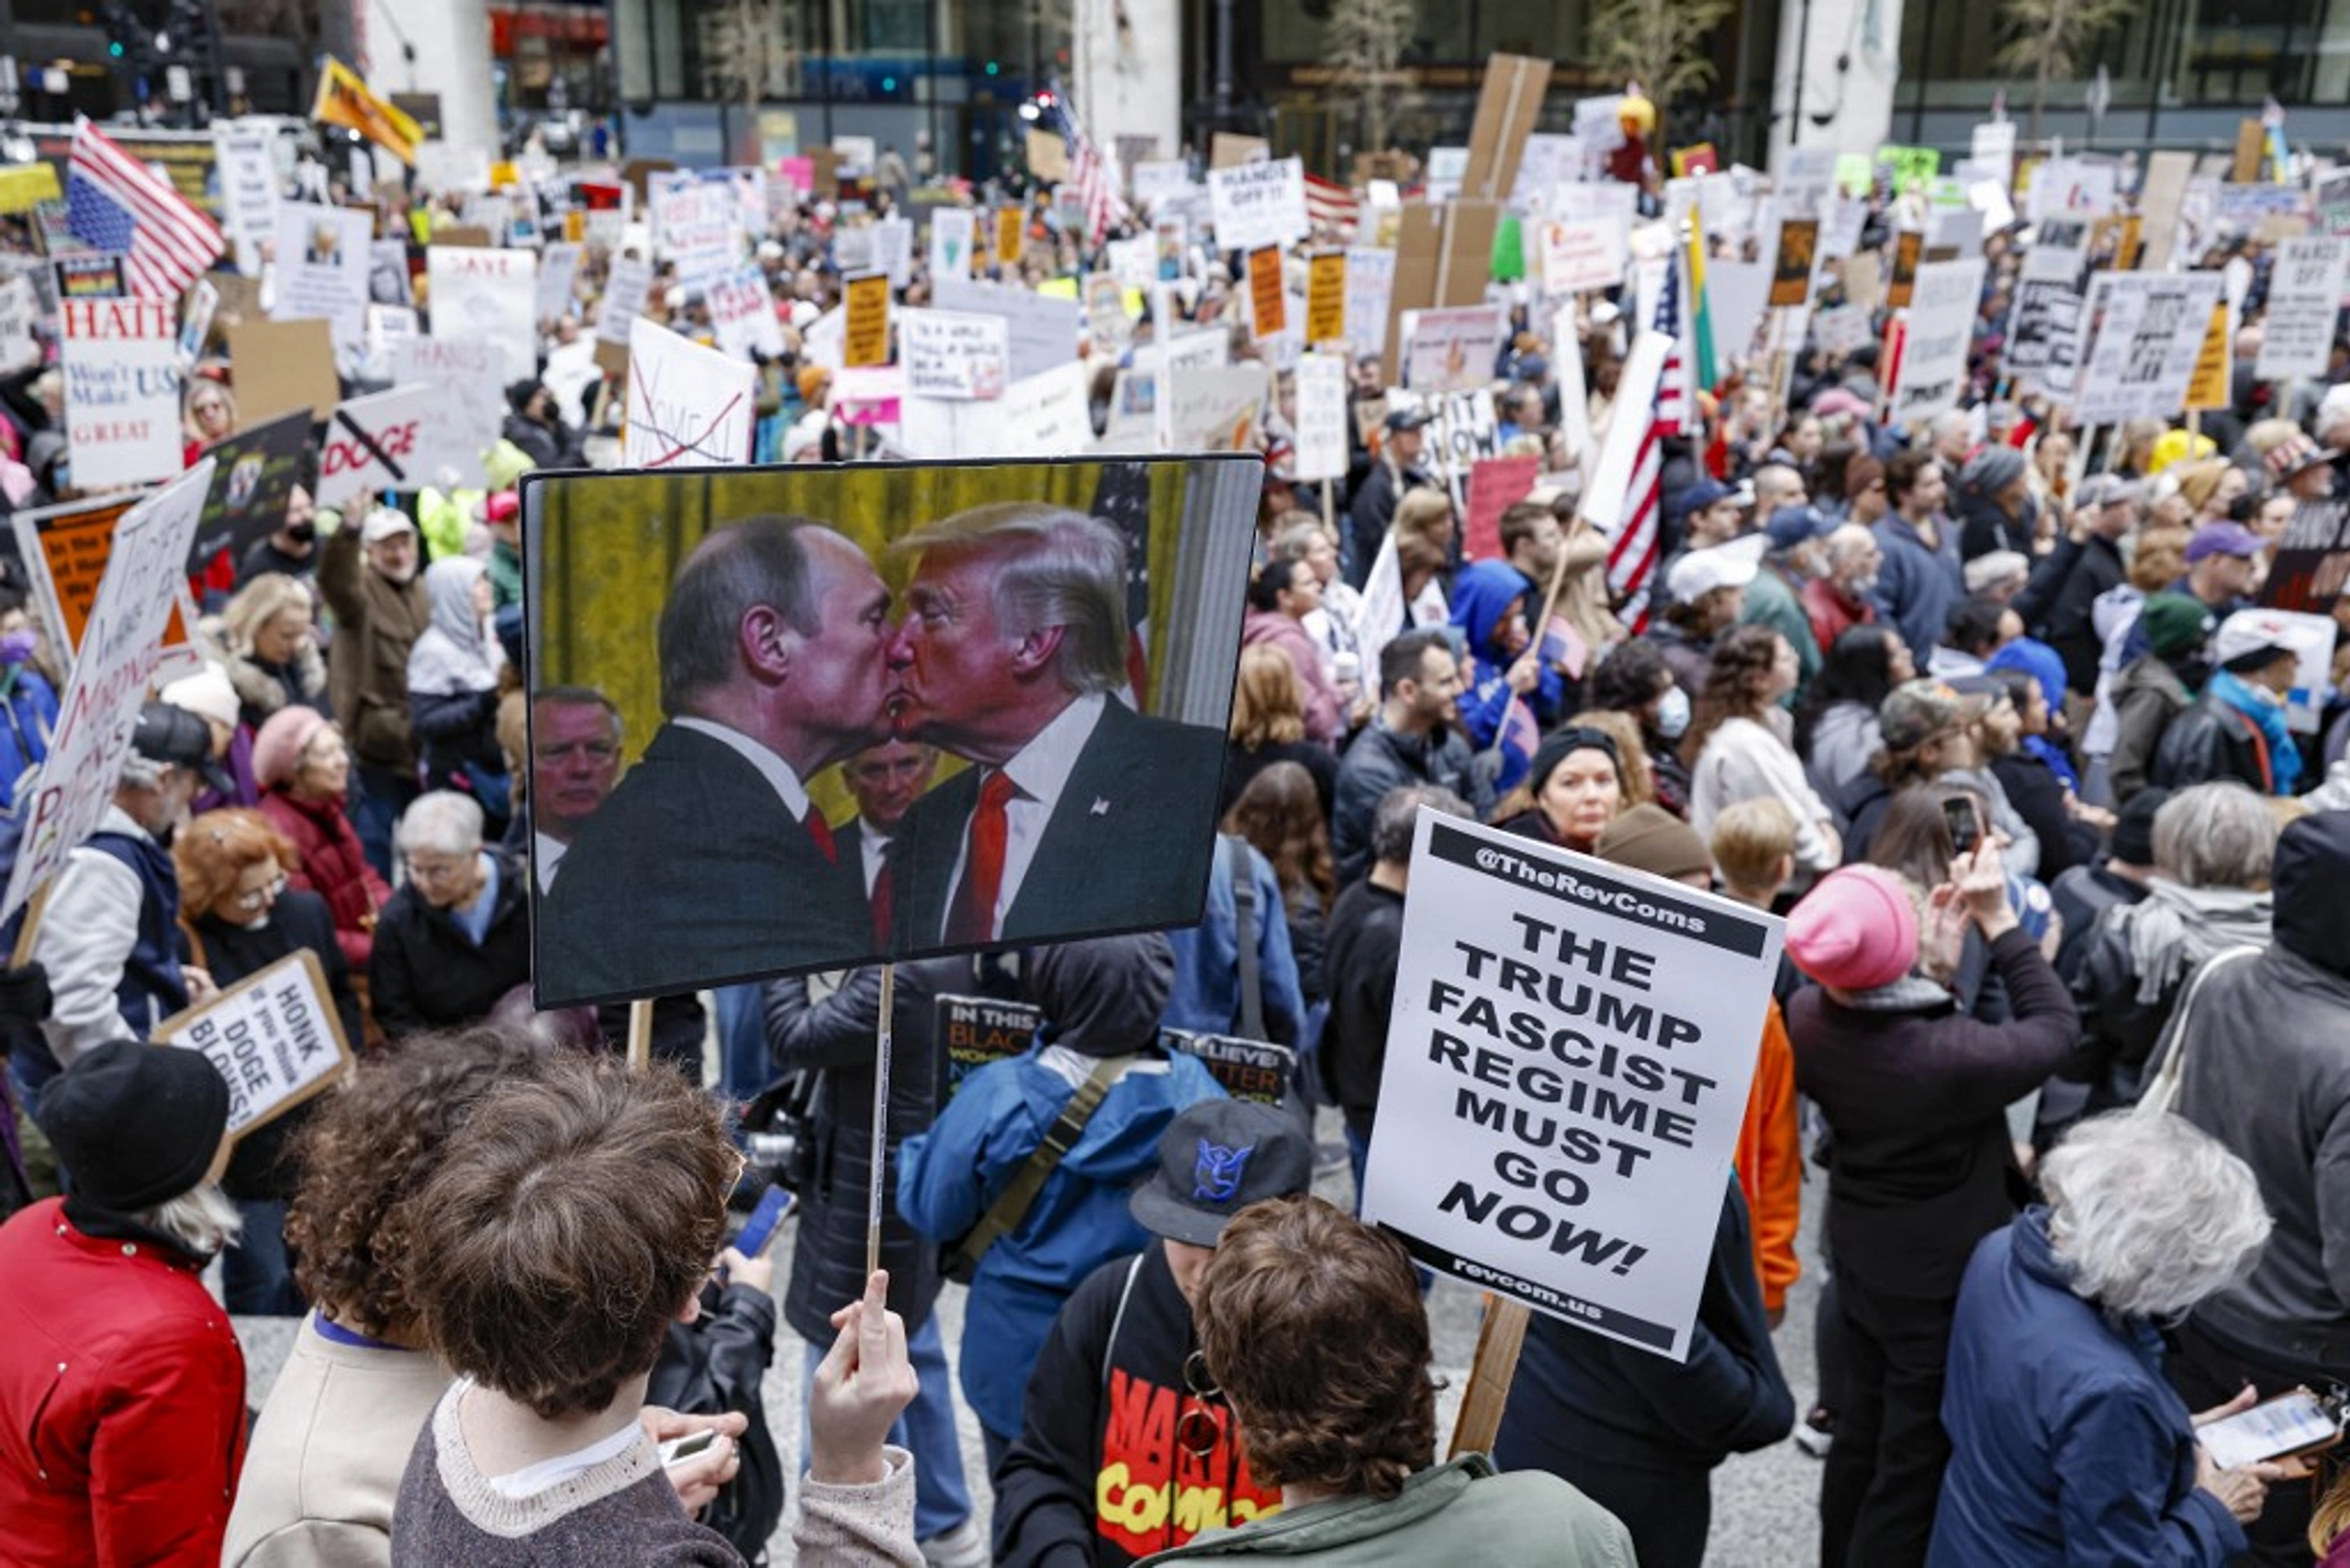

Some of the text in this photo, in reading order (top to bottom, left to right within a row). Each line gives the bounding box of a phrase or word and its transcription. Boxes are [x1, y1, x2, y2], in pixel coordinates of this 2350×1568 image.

[1222, 162, 1289, 187] HANDS
[1231, 187, 1263, 205] OFF
[450, 256, 510, 275] SAVE
[62, 301, 178, 339] HATE
[137, 366, 178, 397] US
[73, 420, 150, 443] GREAT
[1475, 846, 1706, 934] @TheRevComs
[1513, 912, 1656, 991] THE
[276, 983, 323, 1062] HONK
[952, 1005, 1036, 1030] IN THIS
[1455, 940, 1702, 1049] TRUMP
[224, 1018, 272, 1095] DOGE
[1427, 979, 1717, 1105] FASCIST
[1428, 1028, 1697, 1148] REGIME
[1455, 1087, 1651, 1179] MUST
[1494, 1150, 1590, 1206] GO
[1437, 1180, 1649, 1276] NOW!
[1453, 1258, 1604, 1320] revcom.us
